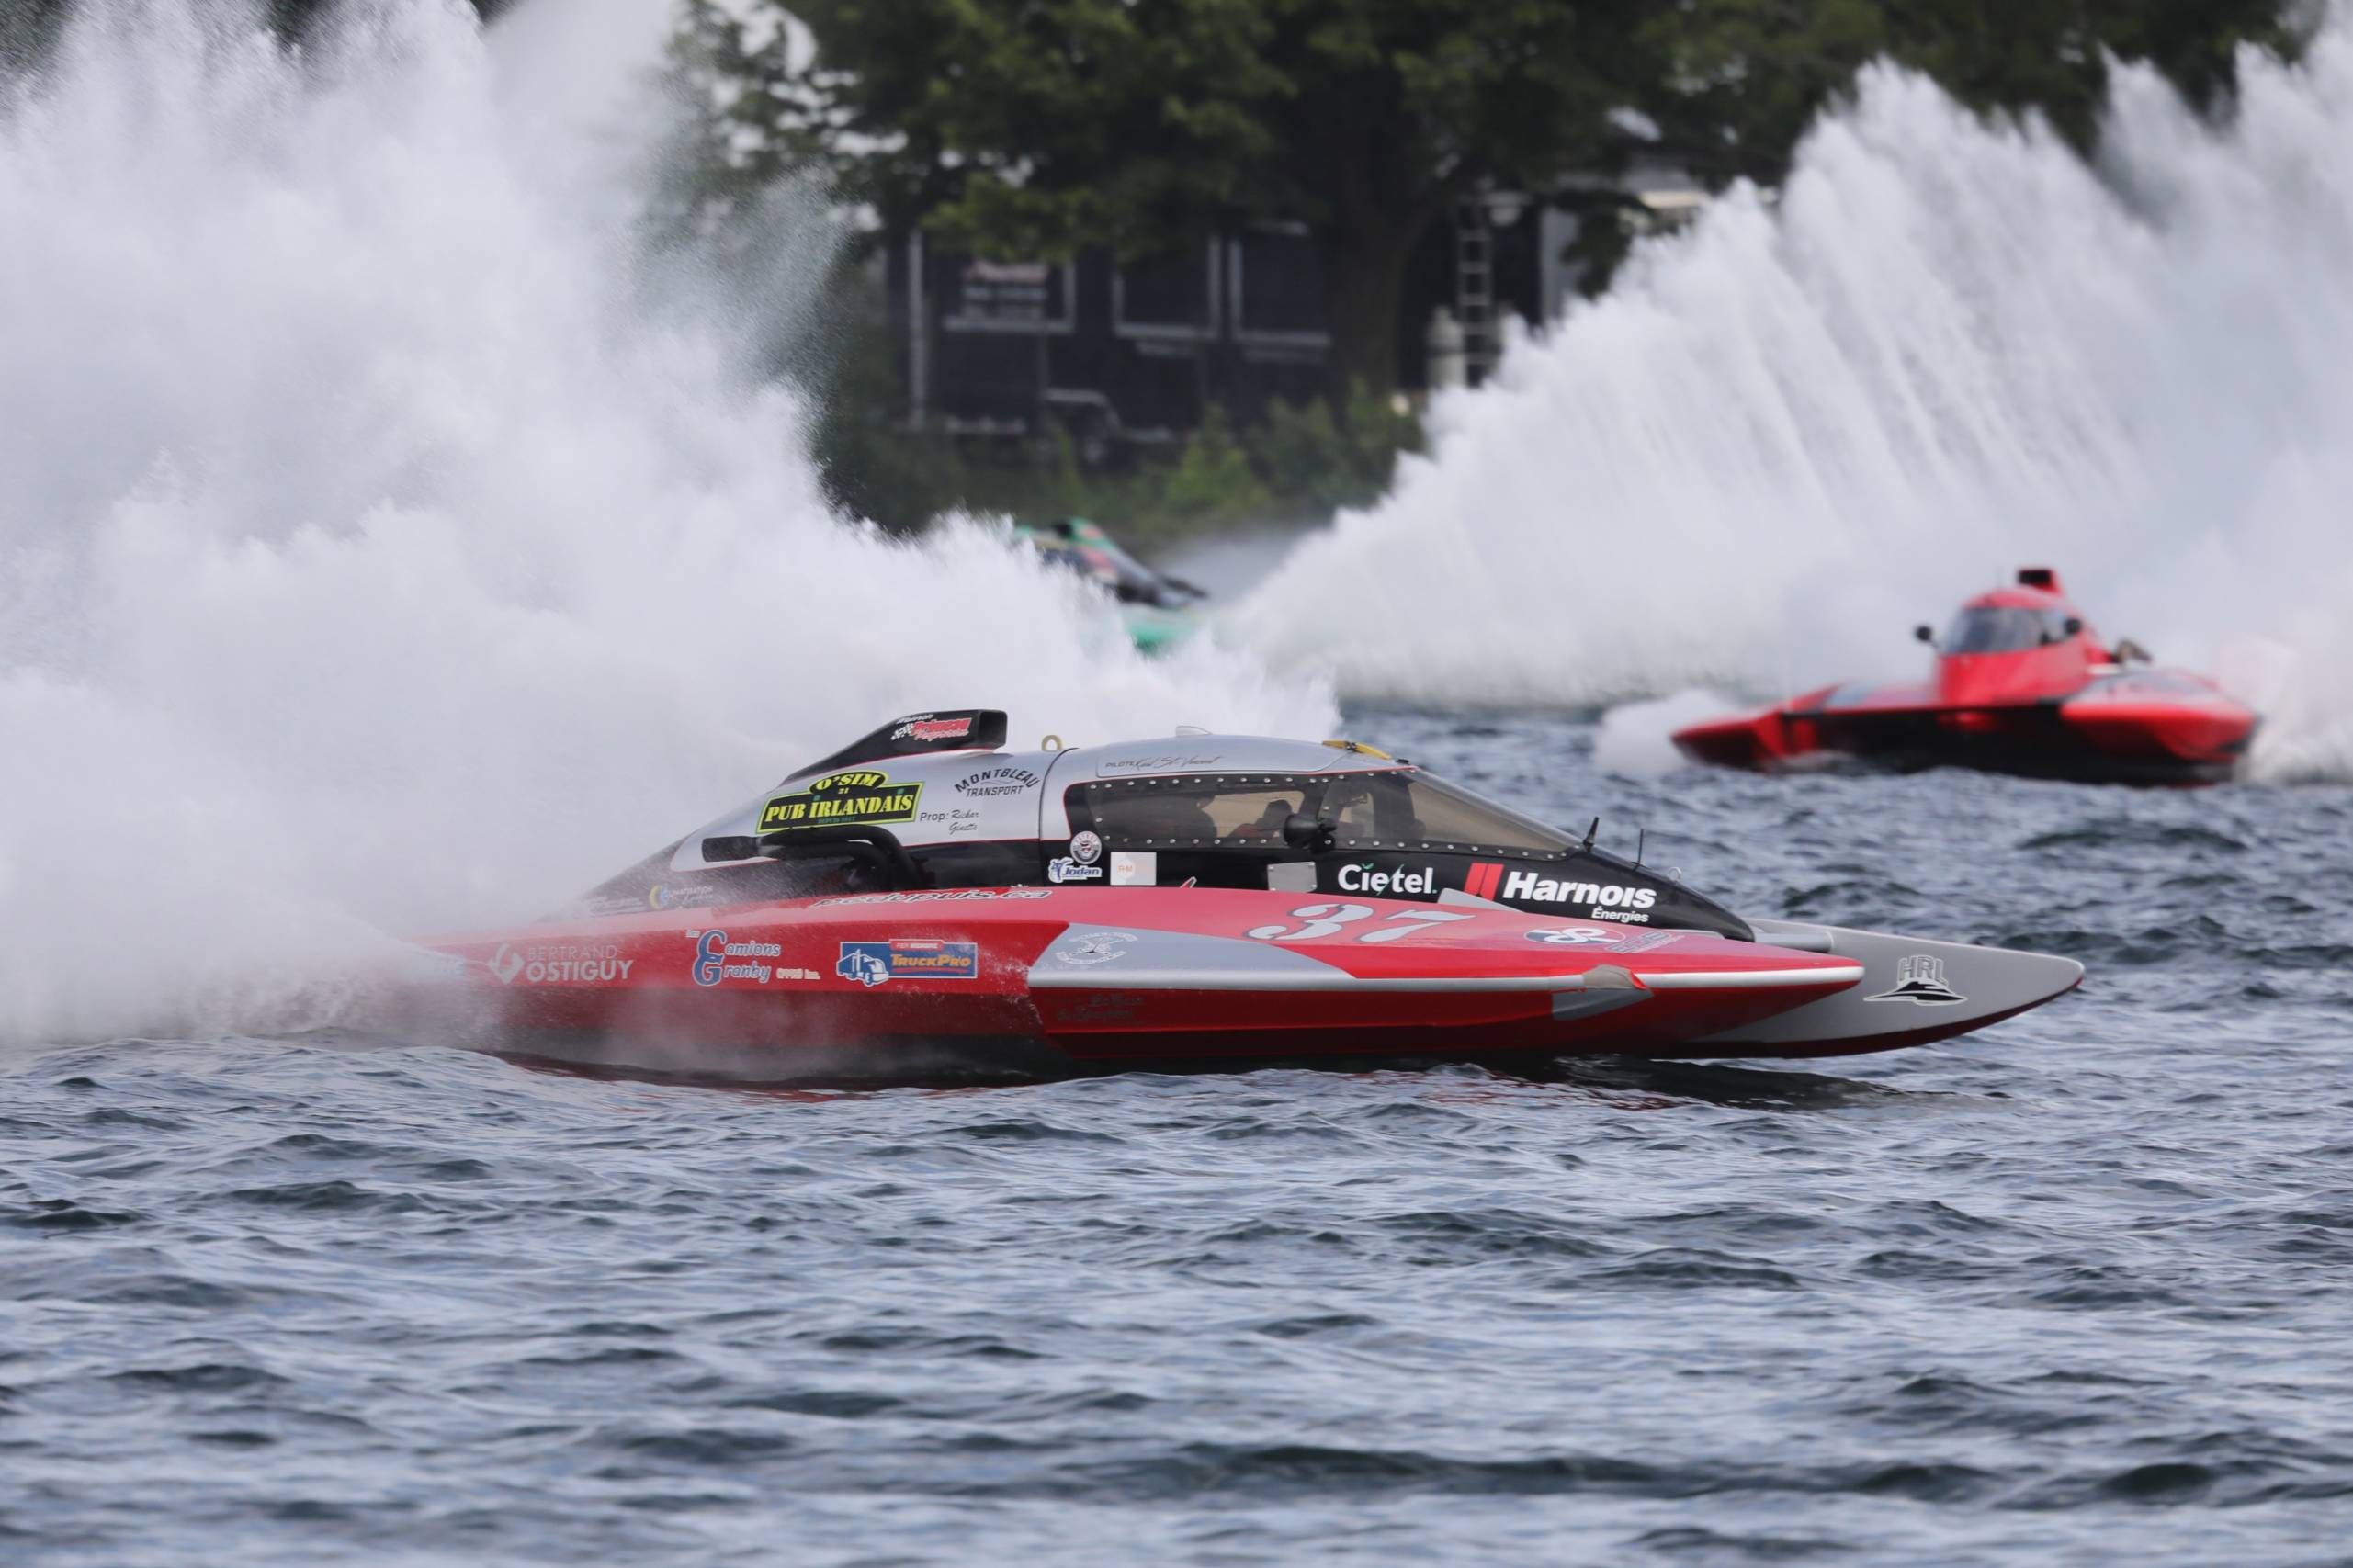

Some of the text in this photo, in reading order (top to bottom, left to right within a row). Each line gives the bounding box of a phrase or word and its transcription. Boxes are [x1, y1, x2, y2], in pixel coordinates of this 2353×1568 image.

[816, 774, 881, 790] O'SIM
[954, 768, 1040, 793] MONTBLEAU
[966, 785, 1024, 797] TRANSPORT
[764, 795, 913, 822] PUB IRLANDAIS
[919, 812, 949, 822] Prop:
[1061, 866, 1100, 875] Jodan
[1502, 871, 1657, 908] Harnois
[1244, 903, 1476, 942] 37
[1591, 906, 1649, 923] Énergies
[528, 945, 619, 960] BERTRAND
[526, 960, 633, 982] OSTIGUY
[1897, 955, 1948, 986] HRL
